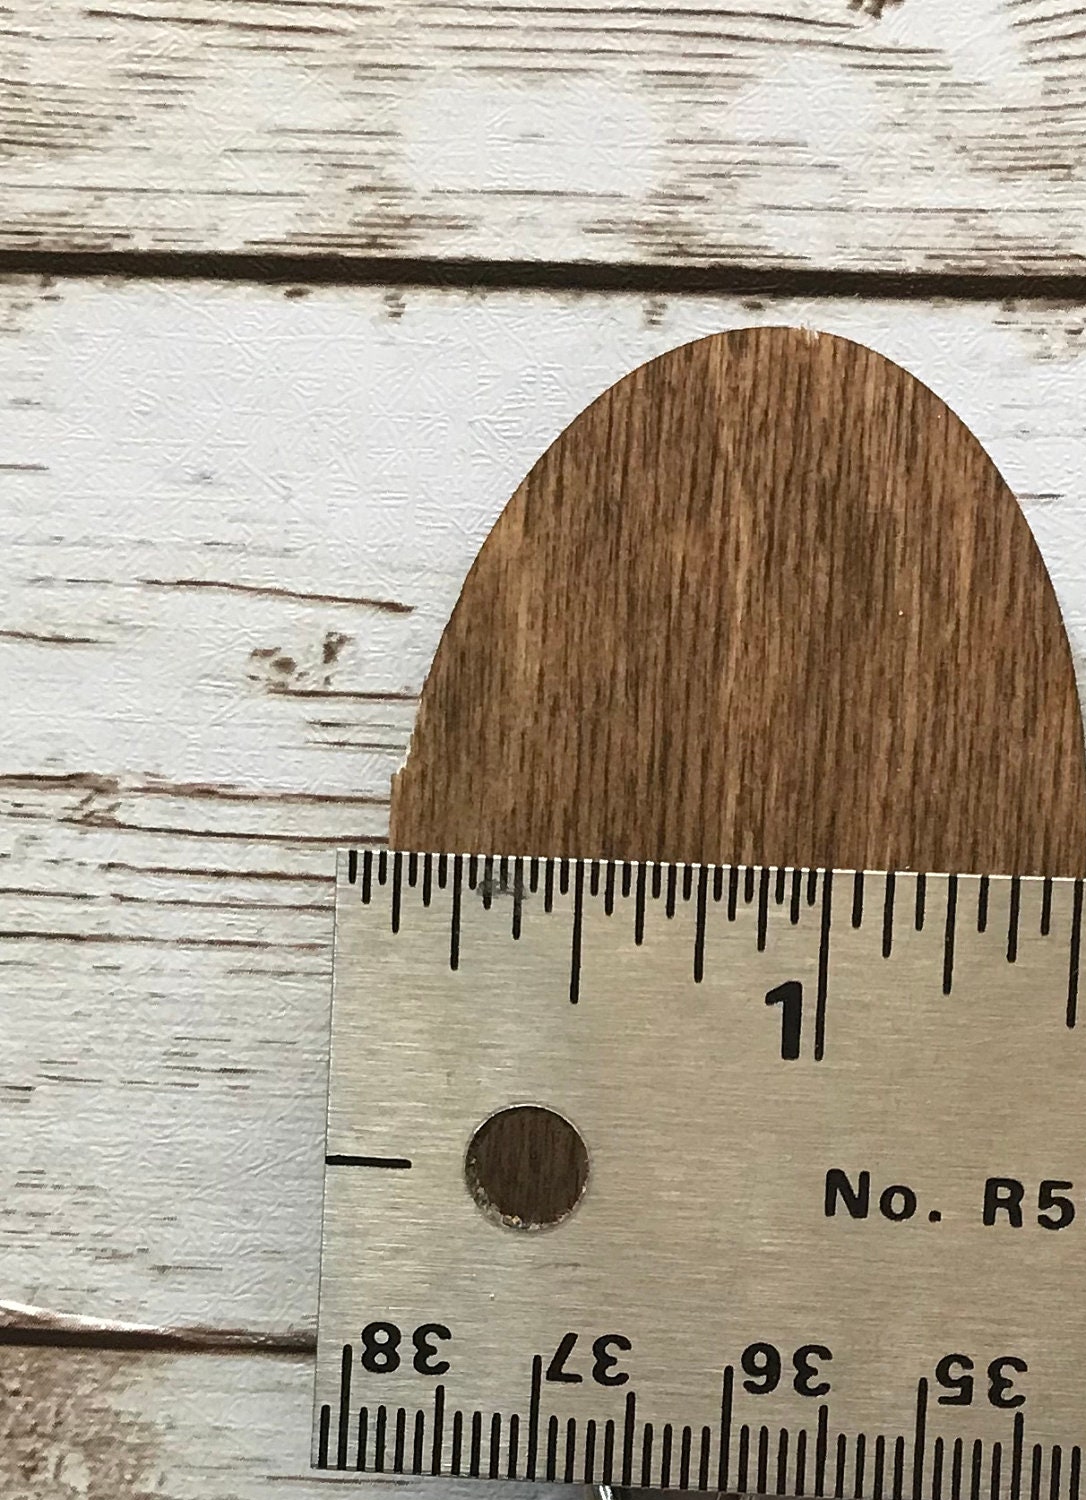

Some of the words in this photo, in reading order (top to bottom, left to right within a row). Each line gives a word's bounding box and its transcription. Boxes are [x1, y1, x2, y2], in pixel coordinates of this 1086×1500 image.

[764, 980, 803, 1061] 1
[824, 1168, 942, 1223] No.
[360, 1321, 452, 1376] 38
[545, 1332, 632, 1387] 37
[740, 1341, 833, 1398] 36
[935, 1353, 1028, 1409] 35
